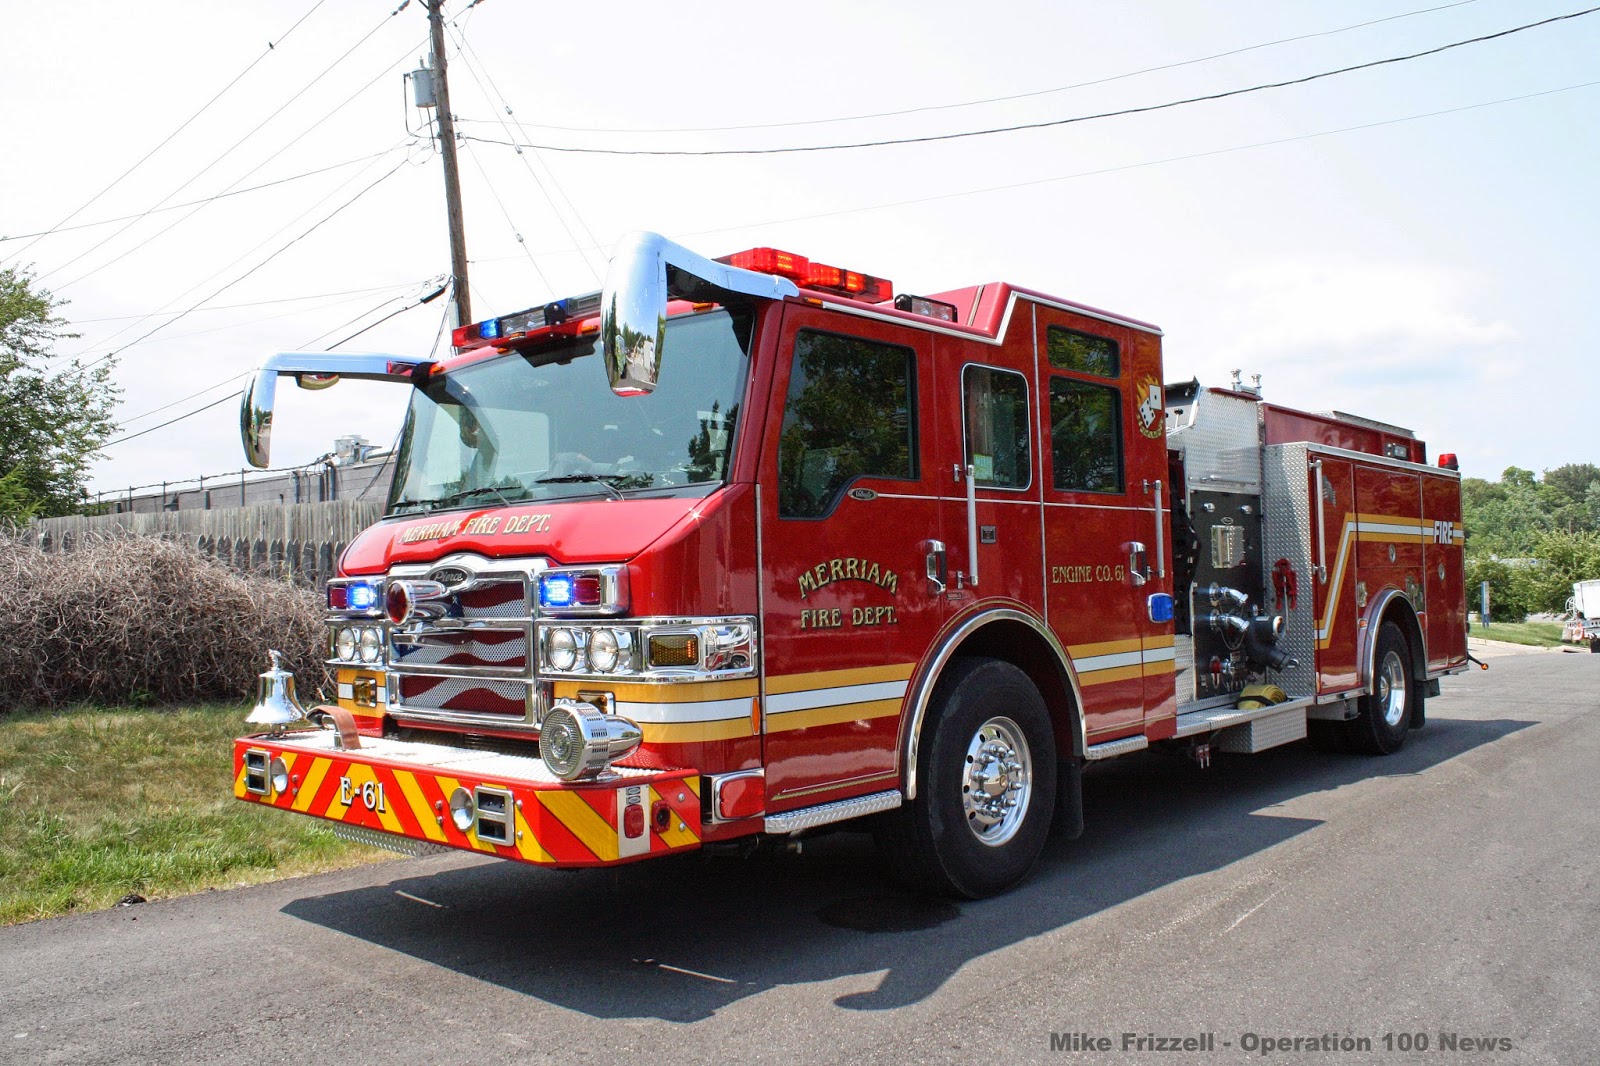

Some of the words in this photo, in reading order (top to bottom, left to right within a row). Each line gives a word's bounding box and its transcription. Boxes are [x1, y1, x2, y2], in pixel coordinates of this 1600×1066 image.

[398, 519, 462, 543] MERRIAM
[461, 514, 500, 535] FIRE
[502, 514, 551, 534] DEPT.
[1433, 520, 1454, 545] FIRE
[434, 570, 464, 582] Pierce
[798, 557, 898, 599] MERRIAM
[1052, 565, 1093, 583] ENGINE
[1095, 564, 1114, 582] CO.
[1115, 564, 1125, 581] 61
[800, 608, 843, 629] FIRE
[852, 606, 898, 626] DEPT.
[340, 776, 386, 813] E-61
